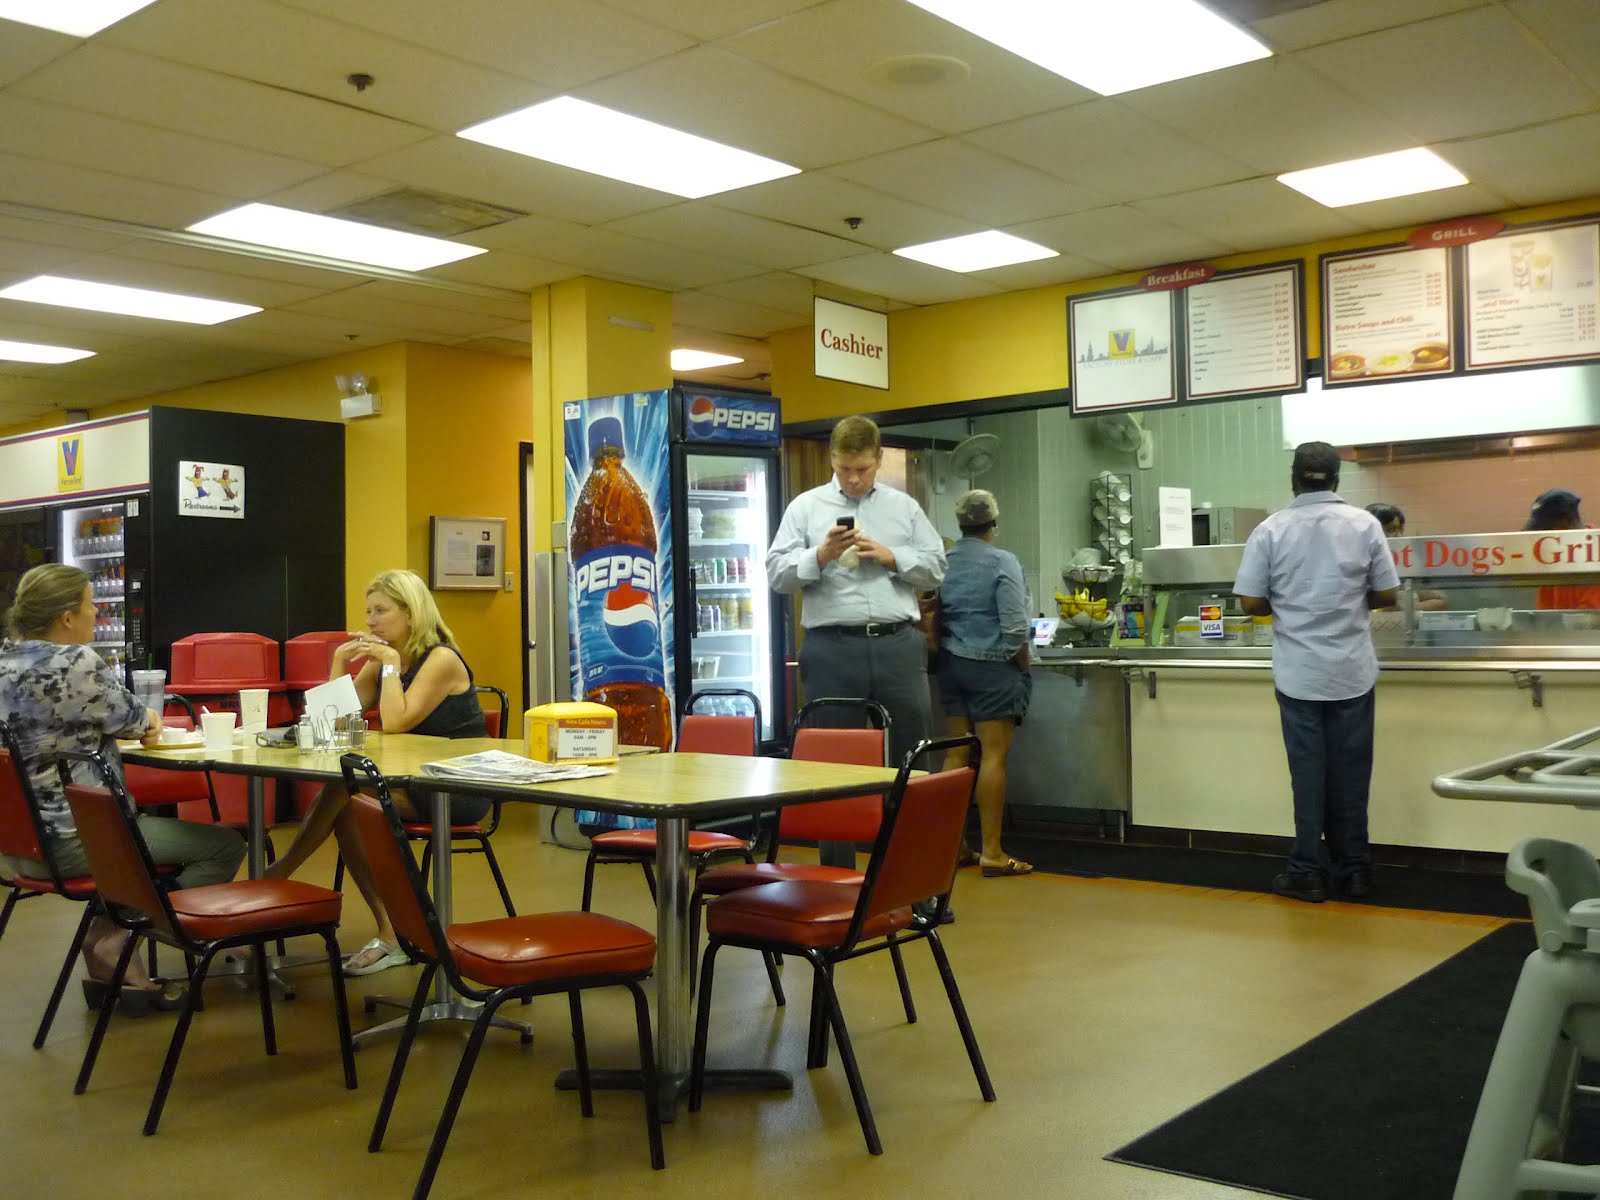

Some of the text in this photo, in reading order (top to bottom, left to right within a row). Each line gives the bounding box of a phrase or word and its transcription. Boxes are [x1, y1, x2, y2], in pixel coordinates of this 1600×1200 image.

[1432, 226, 1477, 242] GRILL
[1146, 267, 1206, 287] Breakfast
[1380, 318, 1396, 326] and
[820, 327, 883, 360] Cashier
[712, 407, 776, 432] PEPSI
[183, 498, 218, 510] Restrooms
[1424, 540, 1505, 575] Dogs
[1533, 534, 1600, 565] Gri
[576, 554, 657, 601] PEPSI
[1203, 623, 1221, 631] VISA
